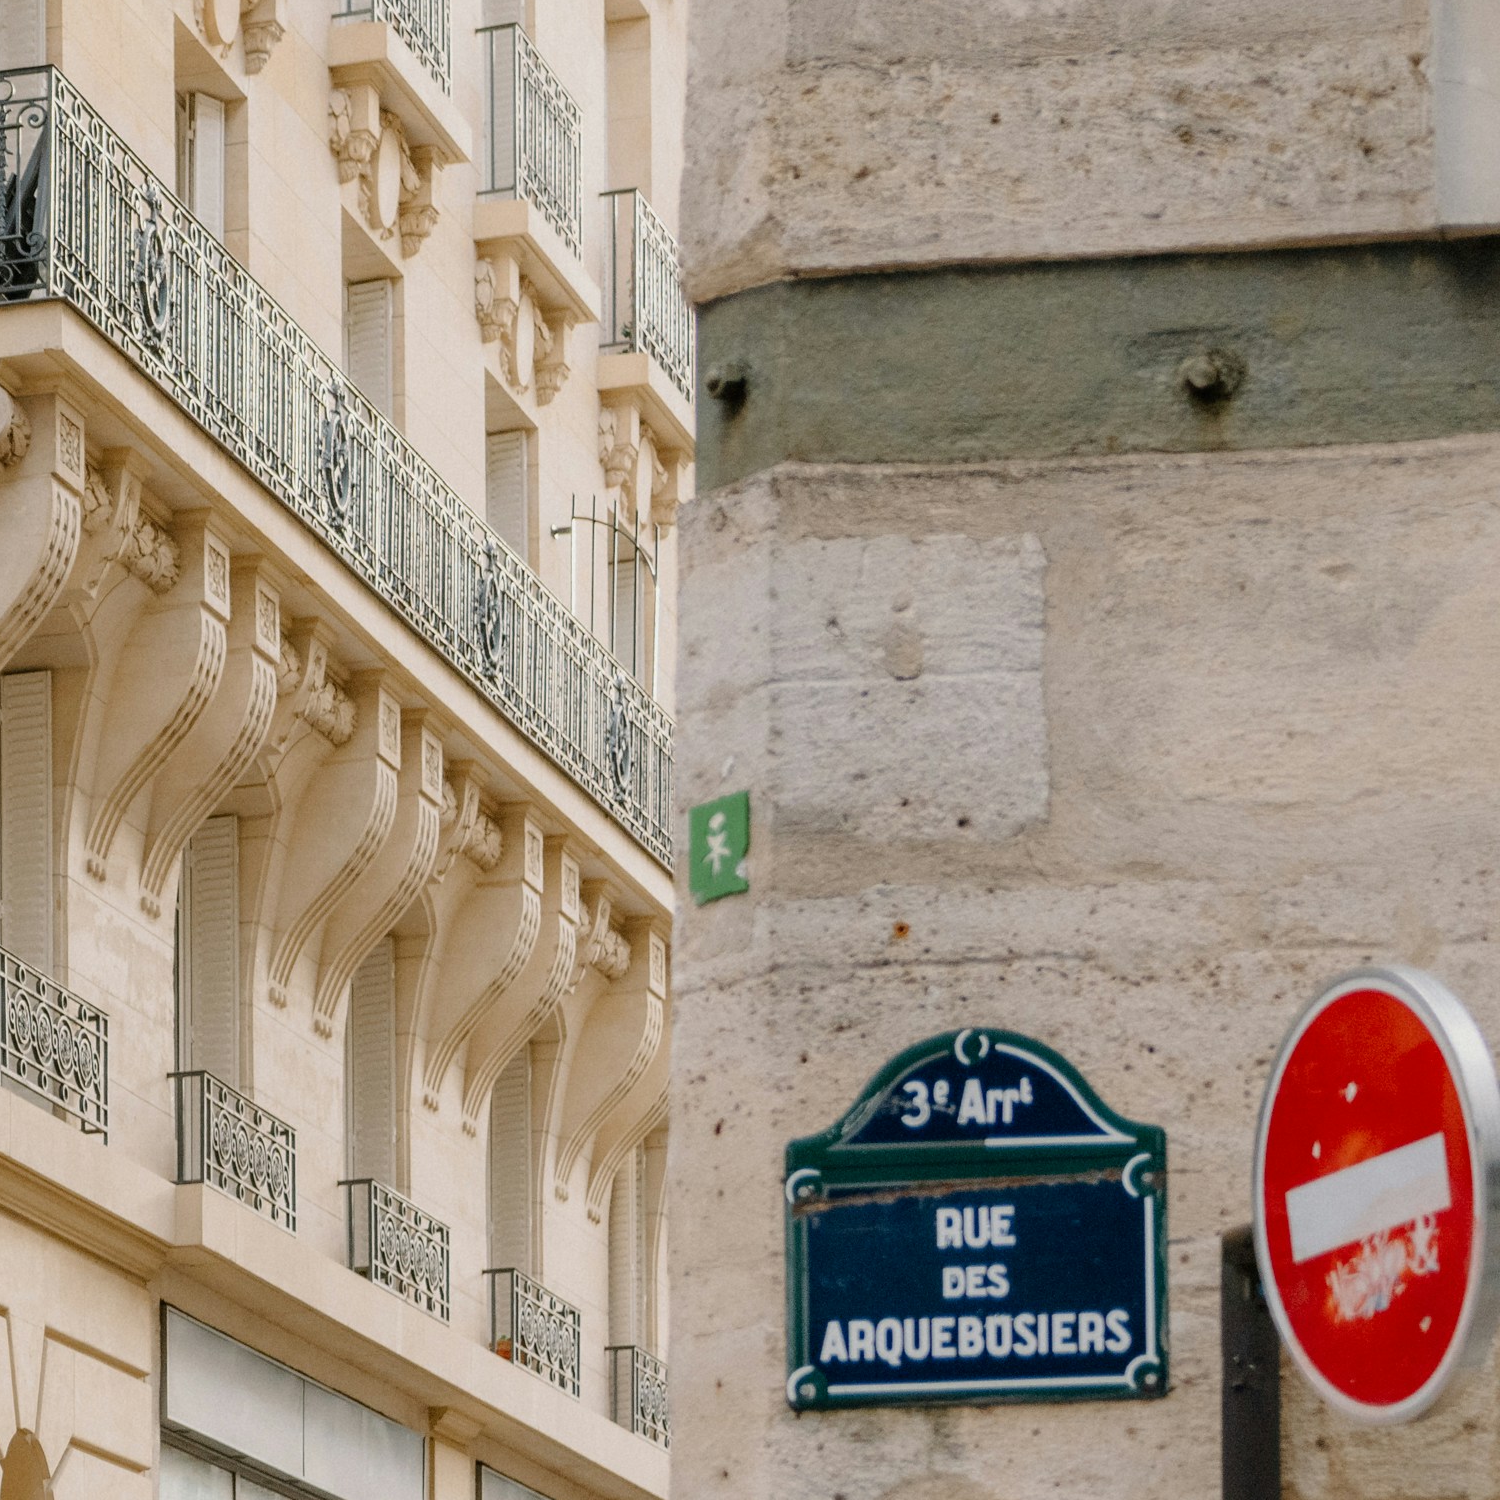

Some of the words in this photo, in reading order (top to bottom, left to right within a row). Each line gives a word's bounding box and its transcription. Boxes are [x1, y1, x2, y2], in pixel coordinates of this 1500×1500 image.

[935, 1204, 1017, 1249] RUE
[941, 1263, 1011, 1300] DES
[819, 1308, 1133, 1368] ARQUEBUSIERS
